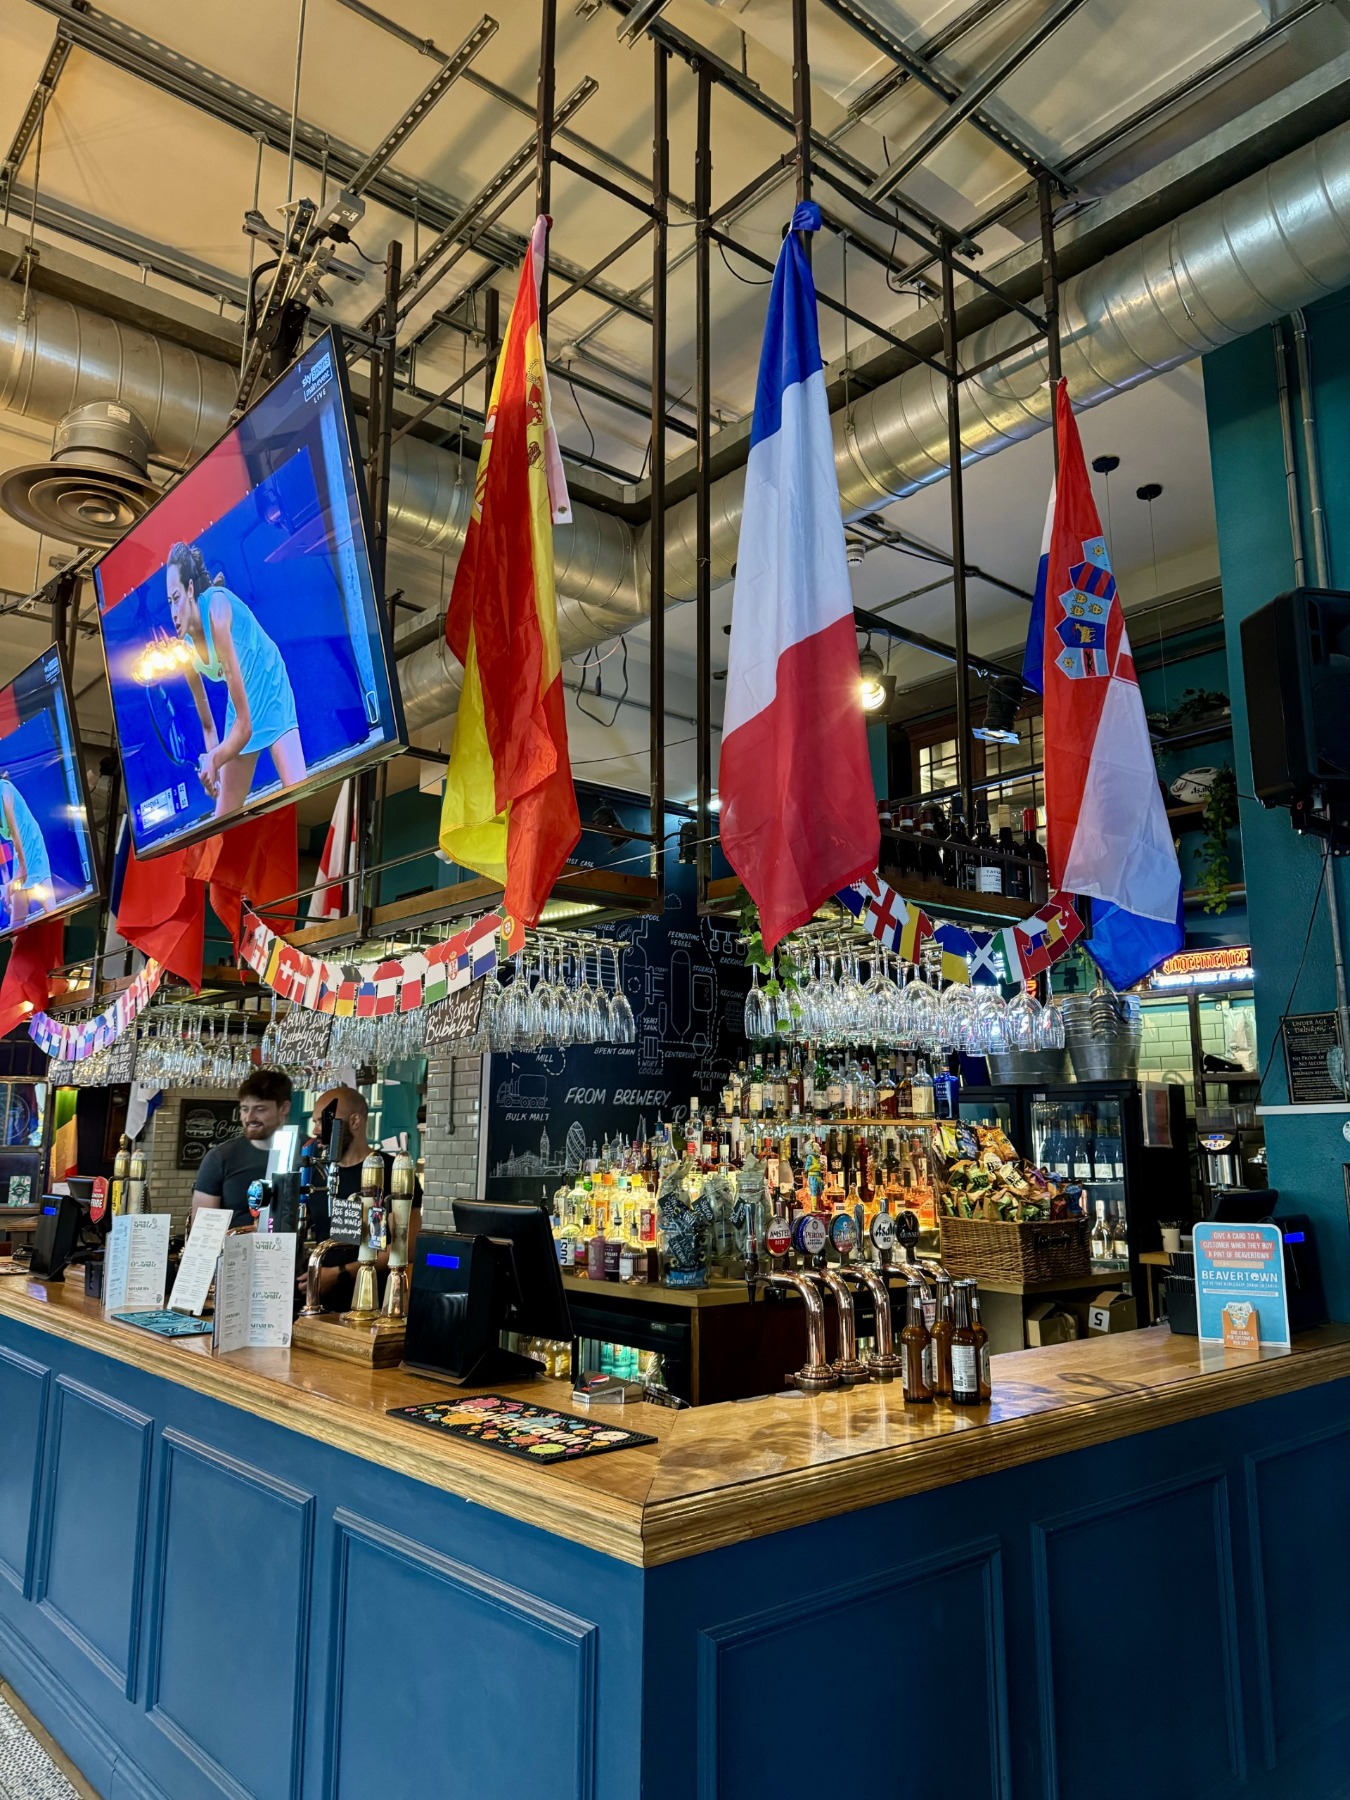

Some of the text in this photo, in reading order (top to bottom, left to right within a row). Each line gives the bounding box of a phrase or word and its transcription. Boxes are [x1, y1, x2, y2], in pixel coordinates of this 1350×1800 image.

[313, 388, 327, 404] LIVE
[580, 860, 595, 868] CASE
[667, 930, 700, 942] FERMENTING
[670, 939, 692, 948] VESSEL
[719, 956, 744, 967] RACKING
[692, 964, 715, 974] STORAGE
[719, 988, 745, 1000] KEGGING
[642, 1017, 659, 1025] YEAST
[643, 1024, 659, 1032] TANK
[593, 1046, 617, 1055] SPENT
[535, 1053, 554, 1063] MILL
[641, 1060, 658, 1068] WORT
[638, 1068, 664, 1076] COOLER
[692, 1070, 728, 1080] FILTRATION
[564, 1086, 607, 1105] FROM
[505, 1112, 550, 1121] BULK MALT
[671, 1104, 688, 1120] TO
[769, 1230, 790, 1238] AMSTEL
[805, 1231, 825, 1239] PERONI
[1213, 1232, 1226, 1240] GIVE
[1232, 1232, 1247, 1240] CARD
[1202, 1241, 1273, 1250] CUSTOMER WHEN THEY BUY
[1213, 1251, 1225, 1259] PINT
[1234, 1252, 1270, 1260] BEAVERTOWN
[1201, 1269, 1279, 1283] BEAVERTOWN
[1094, 1311, 1104, 1327] 5
